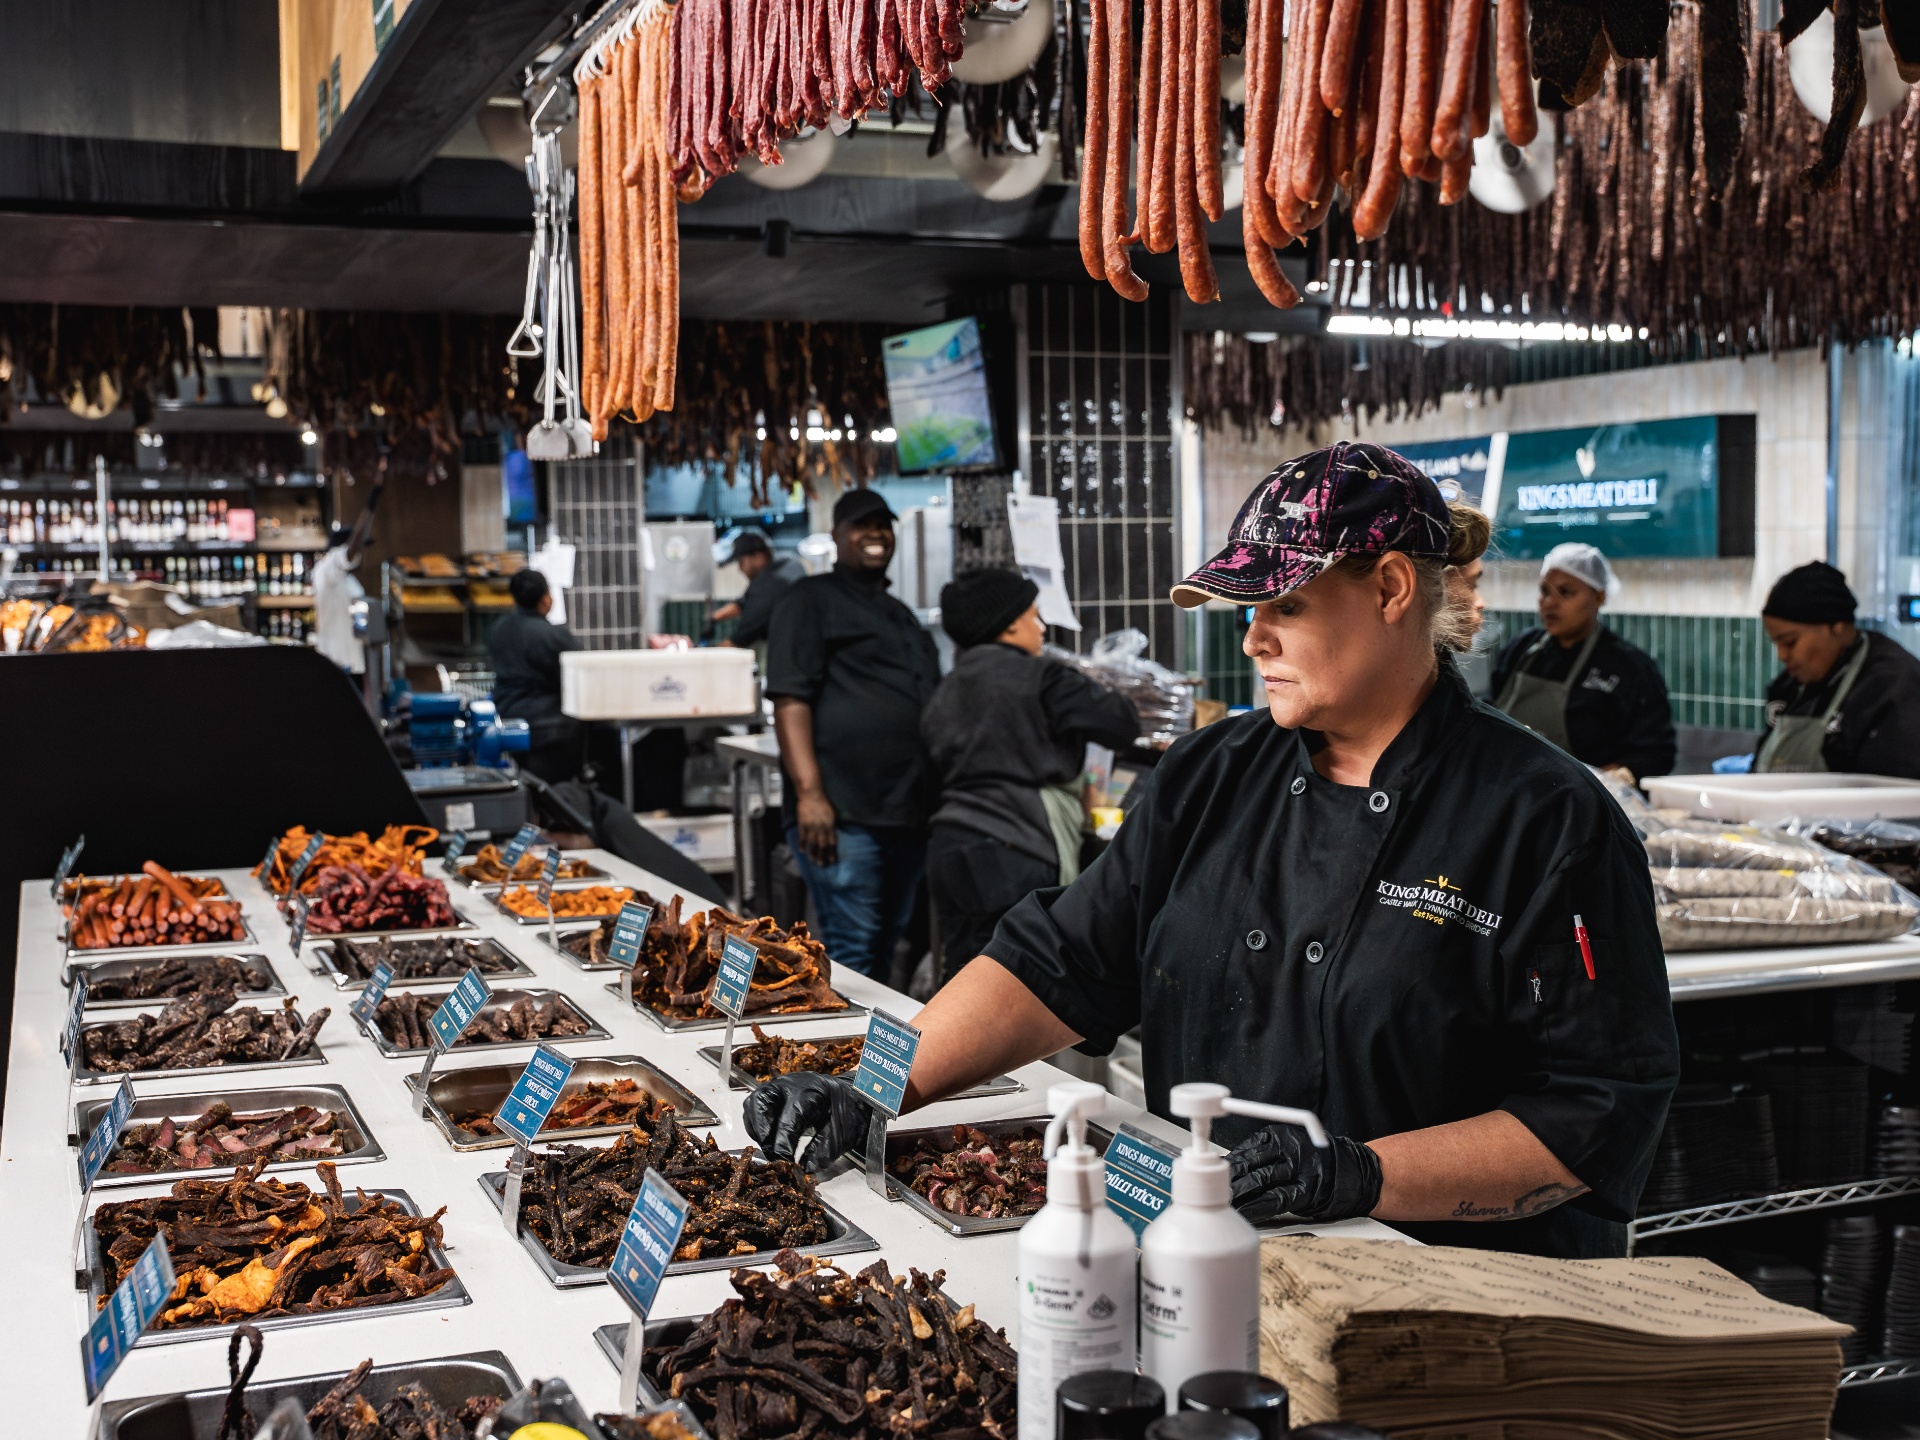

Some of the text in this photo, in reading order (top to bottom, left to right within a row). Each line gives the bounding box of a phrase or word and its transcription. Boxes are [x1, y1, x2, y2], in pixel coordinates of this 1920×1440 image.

[1376, 880, 1503, 929] KINGS MEAT DELI
[1379, 897, 1402, 907] CASTLE
[1423, 902, 1465, 925] LYNNWOOD
[1464, 920, 1491, 937] BRIDGE
[872, 1024, 887, 1039] KINGS
[886, 1031, 901, 1046] MEAT
[899, 1037, 910, 1052] DELI
[863, 1047, 884, 1065] SLICED
[881, 1057, 908, 1081] BILTONG
[1116, 1142, 1140, 1161] KINGS
[1136, 1152, 1159, 1171] MEAT
[1129, 1186, 1164, 1211] STICKS
